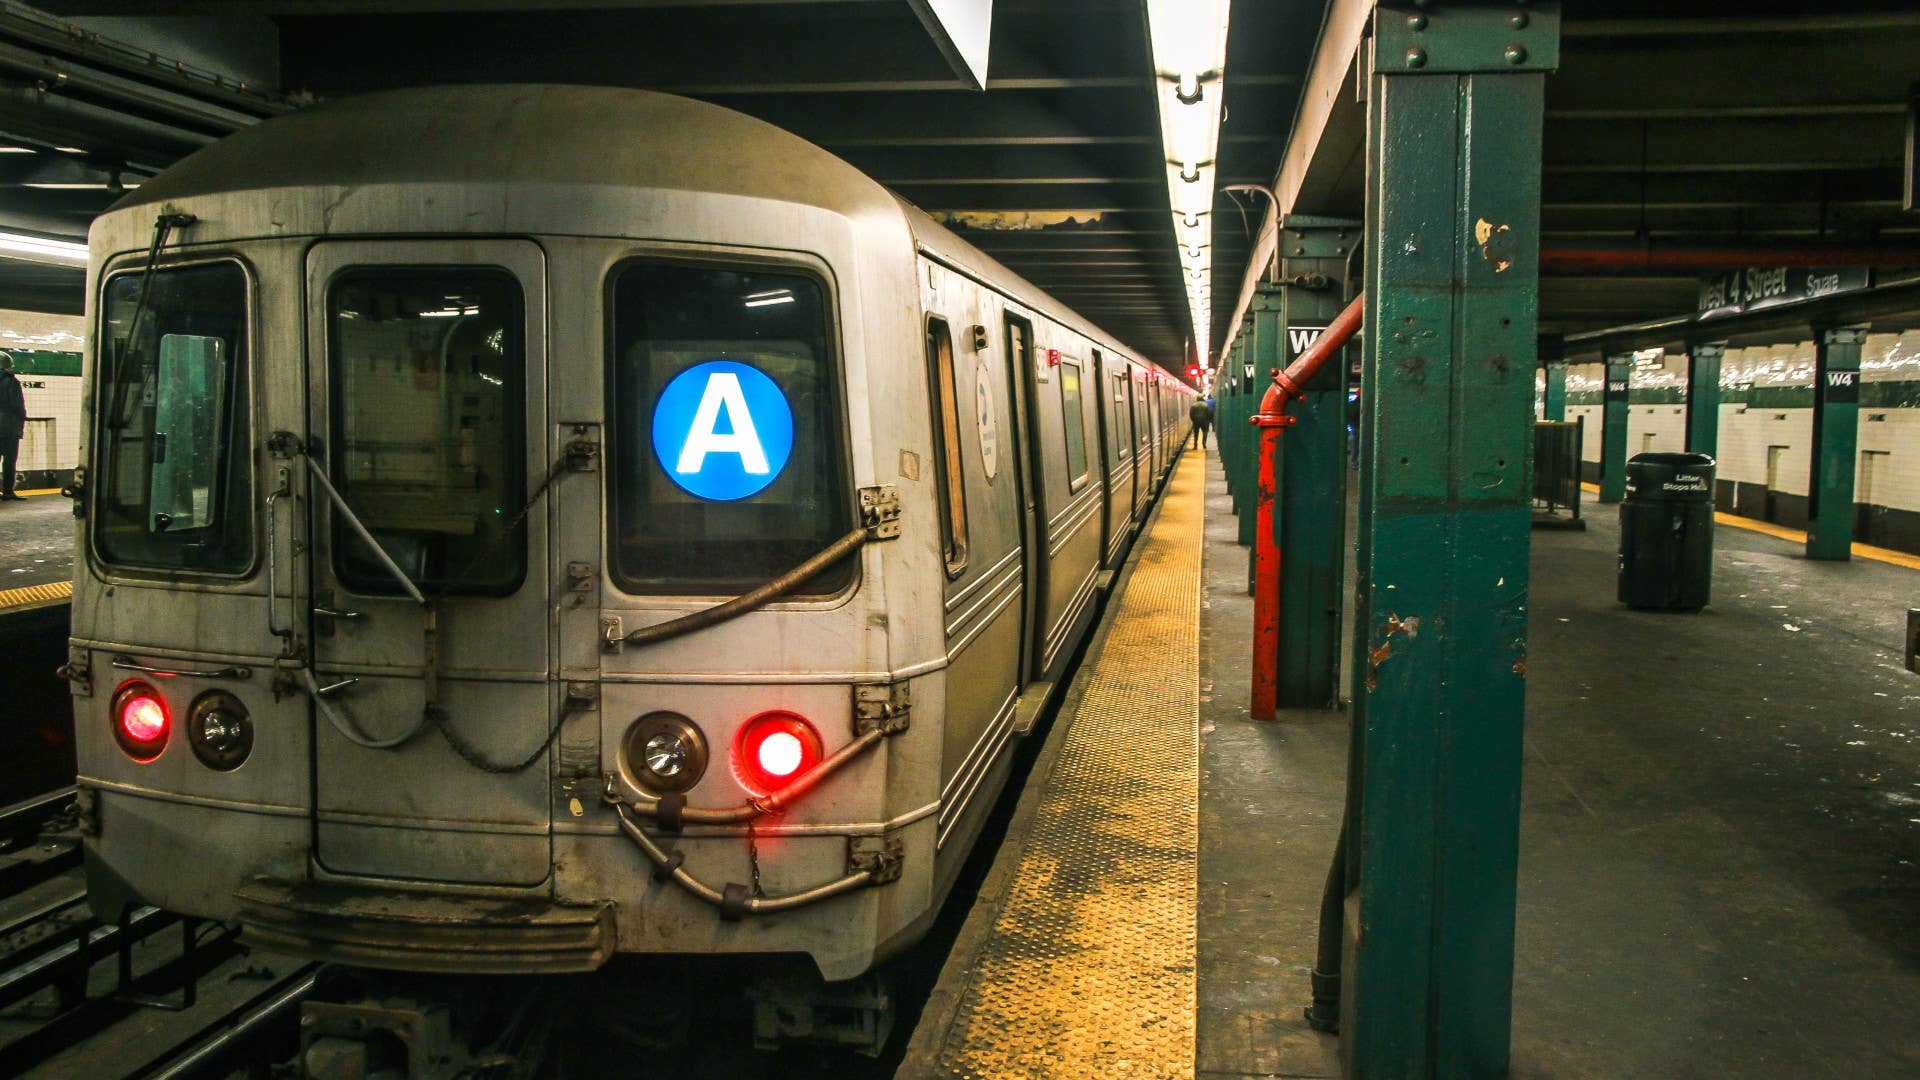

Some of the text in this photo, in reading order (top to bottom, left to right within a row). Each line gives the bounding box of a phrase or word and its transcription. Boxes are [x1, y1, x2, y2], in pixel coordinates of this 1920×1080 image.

[1729, 269, 1740, 304] 4
[1745, 266, 1787, 301] Street
[1289, 330, 1318, 354] W
[1610, 382, 1625, 391] W4
[1827, 373, 1852, 387] W4
[675, 372, 771, 474] A
[1676, 474, 1700, 482] Litter
